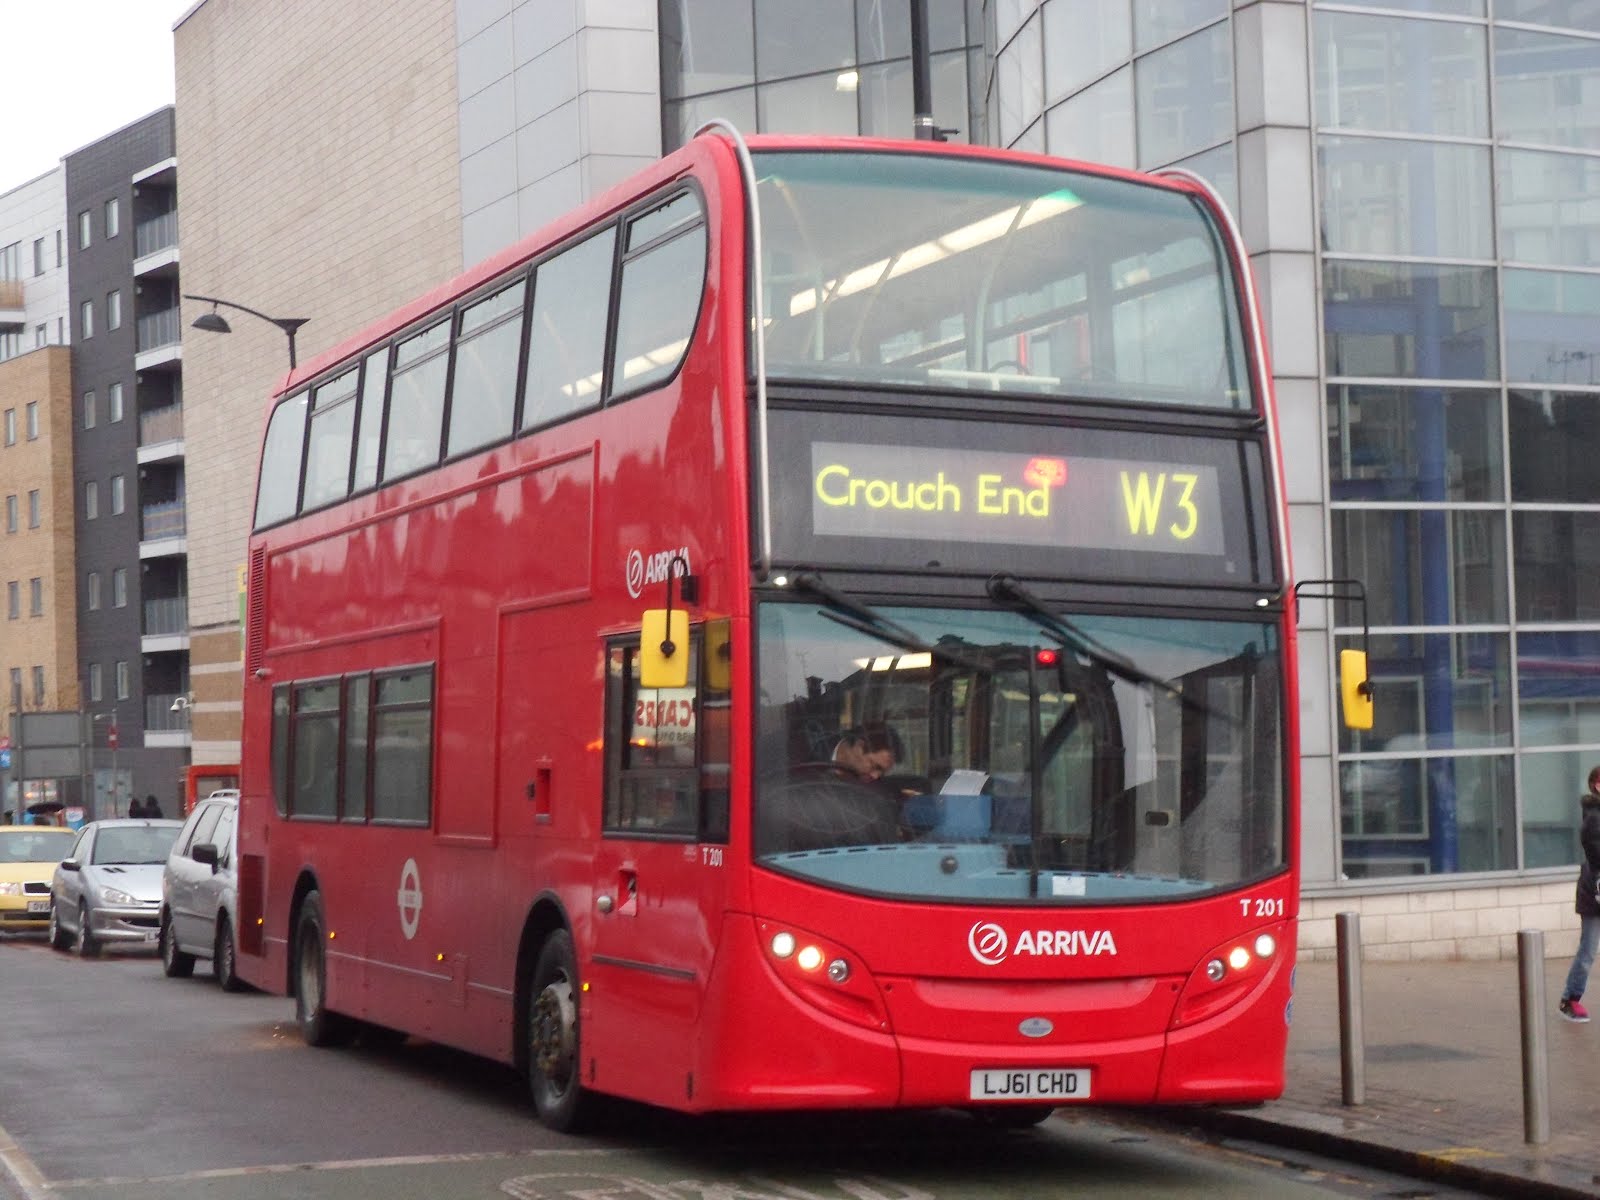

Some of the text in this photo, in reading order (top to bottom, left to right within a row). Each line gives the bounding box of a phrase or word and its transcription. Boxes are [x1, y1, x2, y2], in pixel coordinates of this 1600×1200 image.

[815, 464, 1051, 518] Crouch End
[1119, 470, 1200, 541] W3
[702, 847, 709, 866] T
[709, 848, 723, 867] 201
[1239, 898, 1285, 917] T 201
[1013, 929, 1118, 956] ARRIVA
[984, 1072, 1078, 1095] LJ61 CHD
